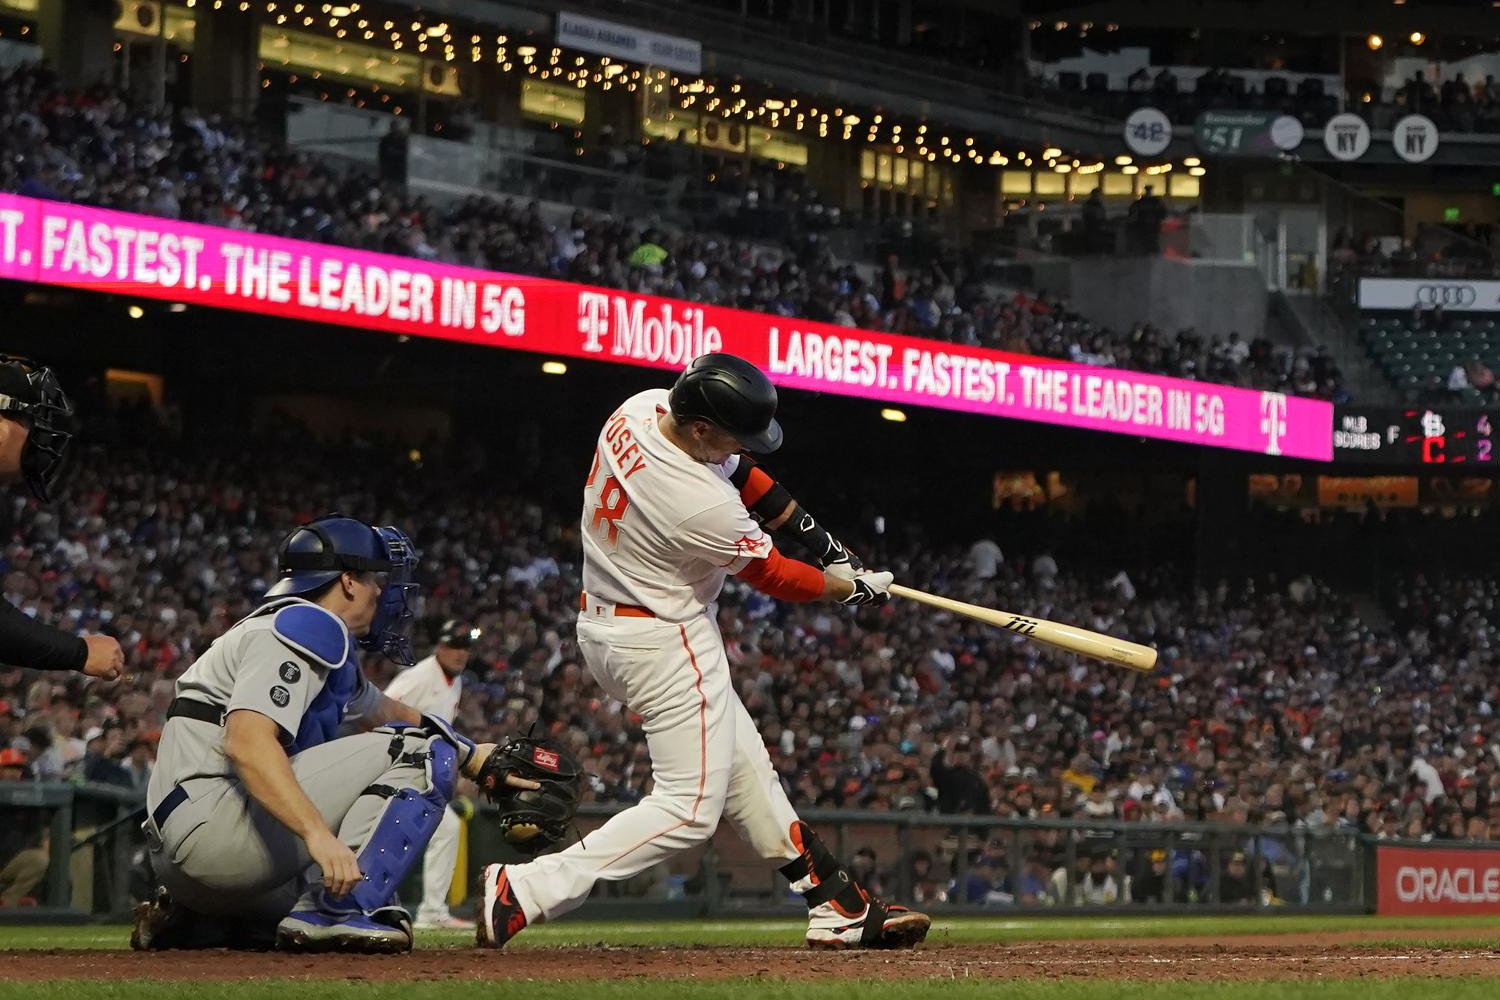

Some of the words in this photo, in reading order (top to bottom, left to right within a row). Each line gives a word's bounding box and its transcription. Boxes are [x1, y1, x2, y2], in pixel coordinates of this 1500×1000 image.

[1337, 133, 1358, 153] NY
[1406, 134, 1426, 154] NY
[42, 215, 212, 291] FASTEST.
[221, 243, 292, 303] THE
[298, 255, 434, 324] LEADER
[440, 277, 476, 329] IN
[481, 283, 525, 336] 5G
[611, 296, 722, 367] Mobile
[769, 327, 898, 389] LARGEST.
[903, 348, 1015, 405] FASTEST.
[1019, 365, 1068, 412] THE
[1071, 374, 1163, 426] LEADER
[1166, 389, 1191, 432] IN
[1195, 393, 1225, 436] 5G
[604, 408, 647, 481] POSEY
[1478, 439, 1492, 461] 2
[1396, 866, 1500, 903] ORACLE
